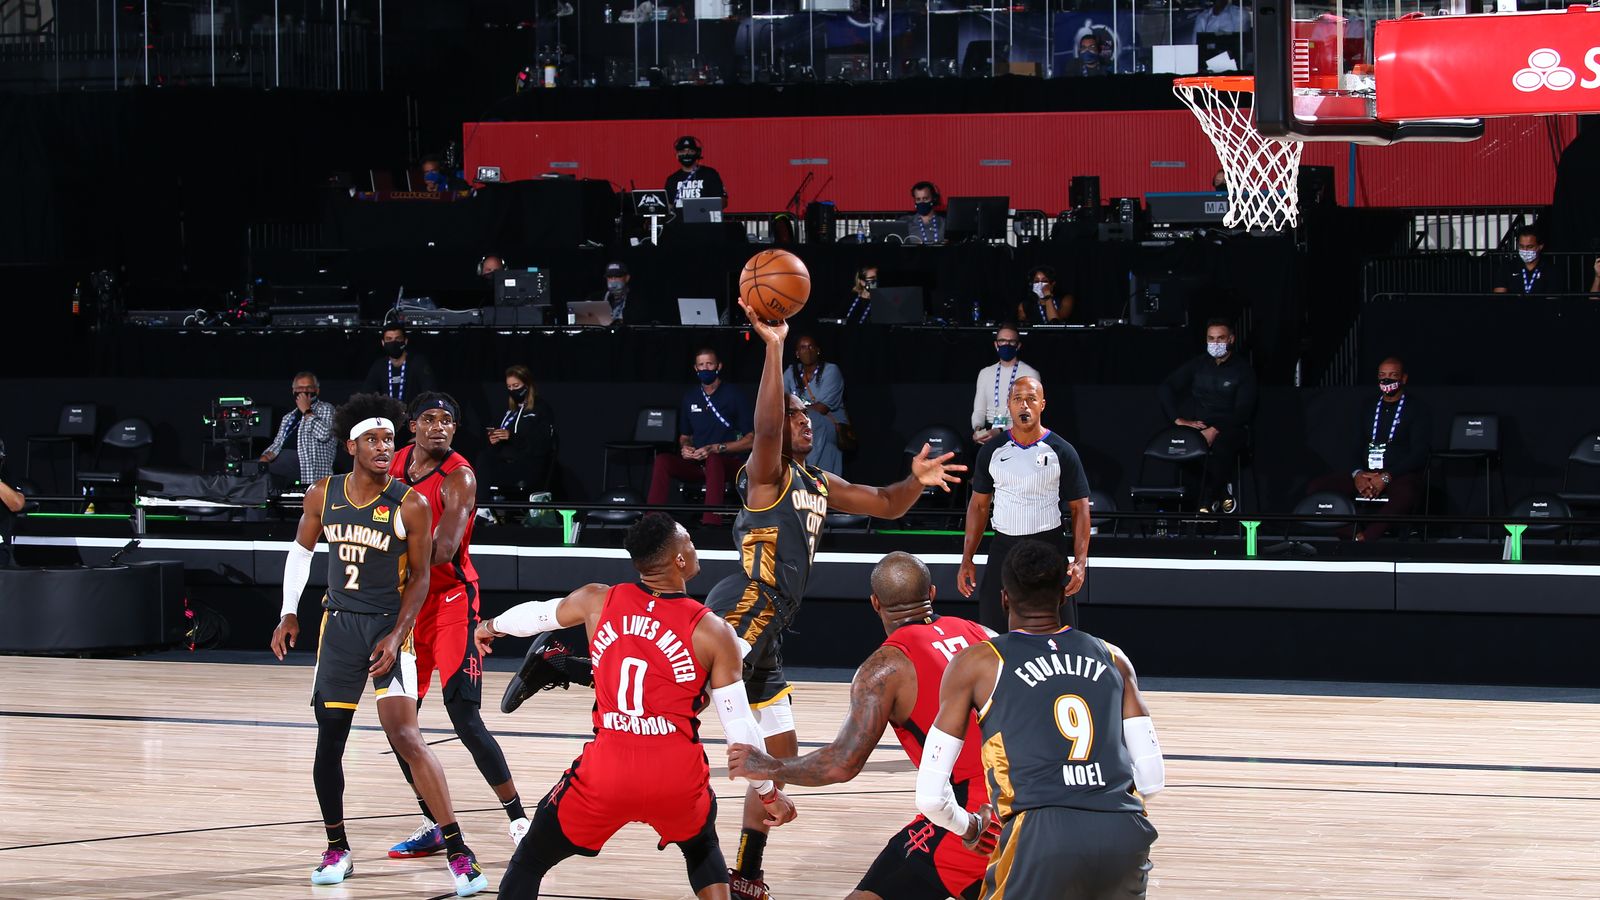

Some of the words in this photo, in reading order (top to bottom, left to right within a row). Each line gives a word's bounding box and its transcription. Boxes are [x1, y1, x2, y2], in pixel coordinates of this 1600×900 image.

[677, 180, 704, 189] BLACK
[679, 189, 701, 198] LIVES
[323, 524, 391, 552] OKLAHOMA
[339, 545, 367, 563] CITY
[344, 565, 360, 590] 2
[592, 621, 619, 667] BLACK
[622, 615, 661, 641] LIVES
[656, 630, 697, 684] MATTER
[1014, 653, 1107, 688] EQUALITY
[617, 656, 648, 717] 0
[1053, 694, 1094, 761] 9
[1063, 762, 1106, 786] NOEL
[733, 880, 763, 899] SHAW
